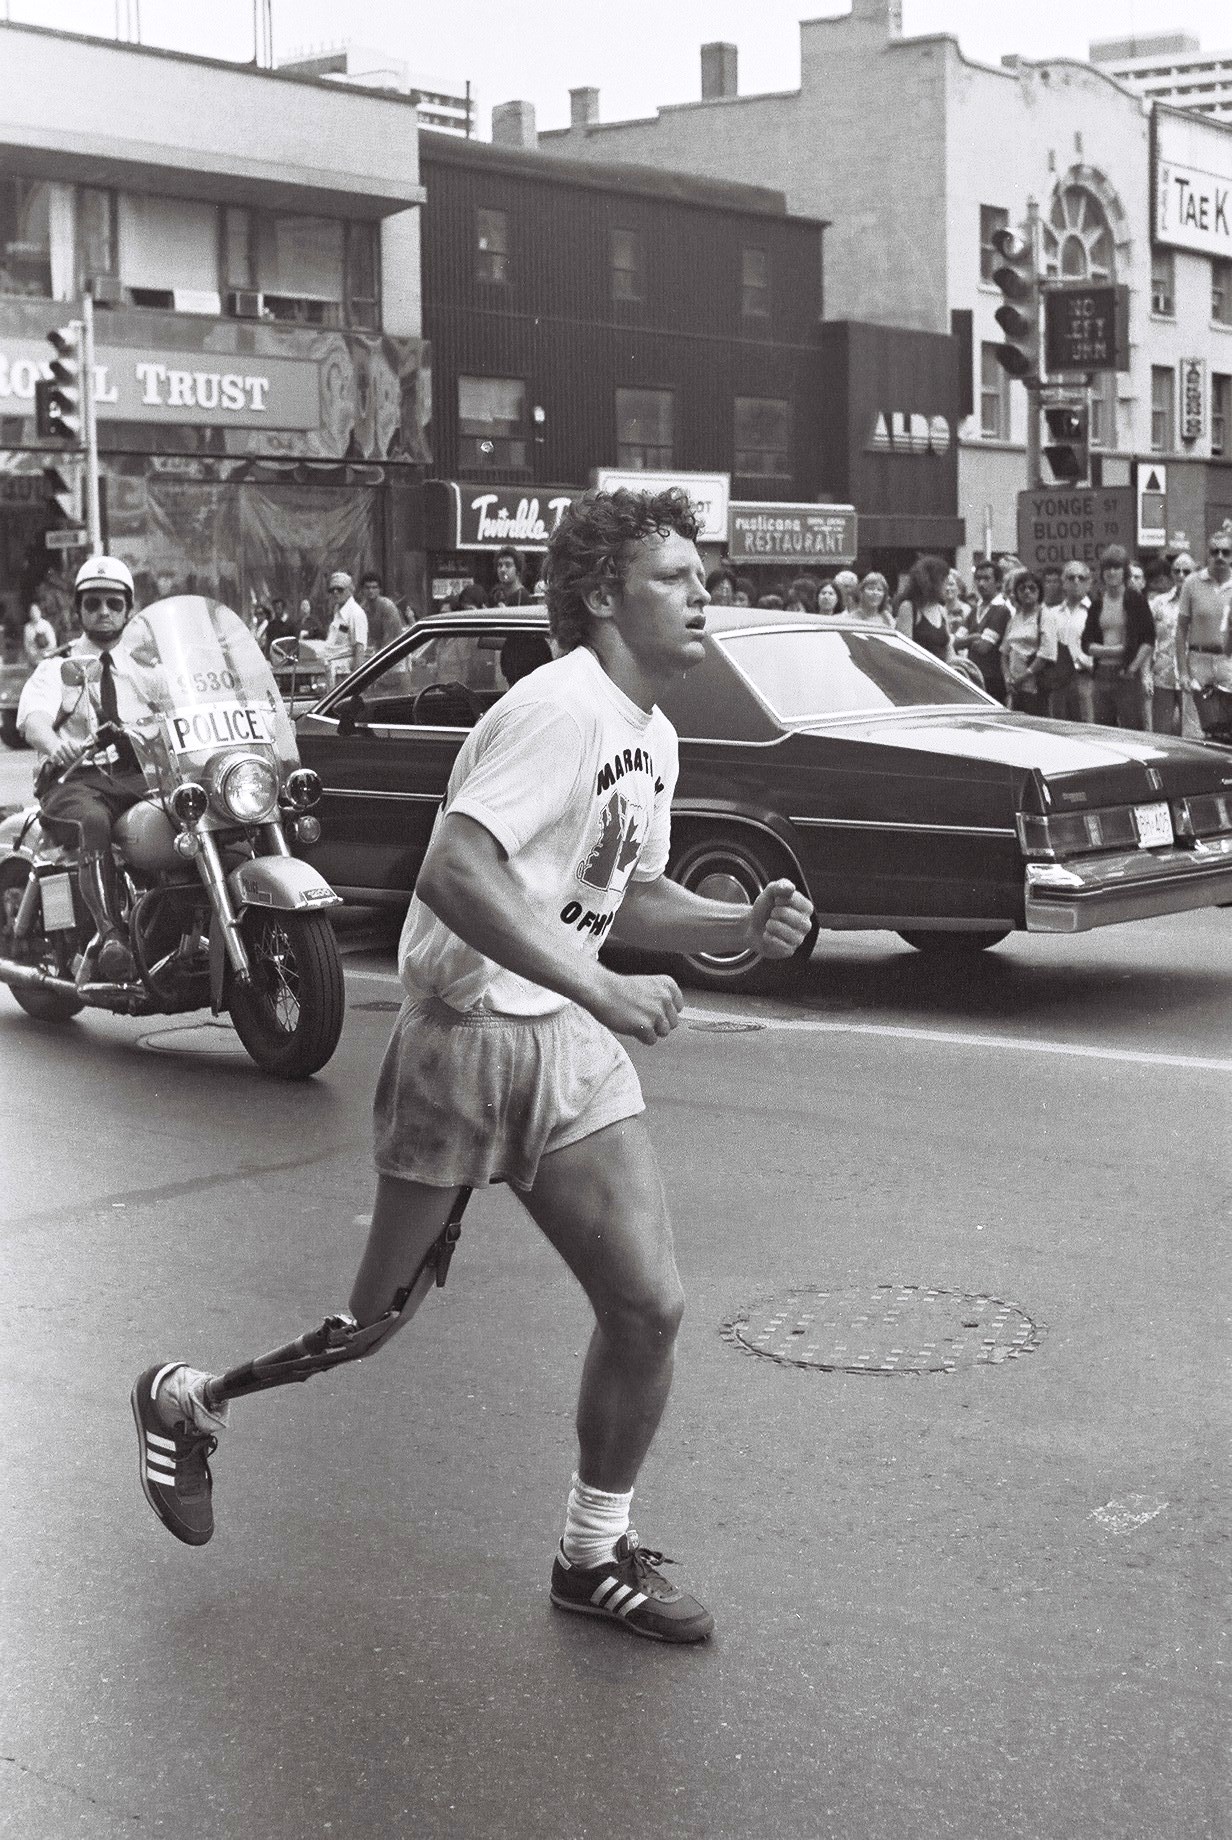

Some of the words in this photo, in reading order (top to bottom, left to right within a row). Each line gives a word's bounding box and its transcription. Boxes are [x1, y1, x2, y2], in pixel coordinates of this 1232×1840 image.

[136, 362, 269, 412] TRUST
[471, 494, 549, 541] Twinkle
[1032, 497, 1093, 517] YONGE
[744, 531, 845, 553] RESTAURANT
[1033, 520, 1094, 540] BLOOR
[1035, 543, 1106, 563] COLLE
[173, 709, 264, 749] POLICE
[597, 747, 665, 796] MARATN
